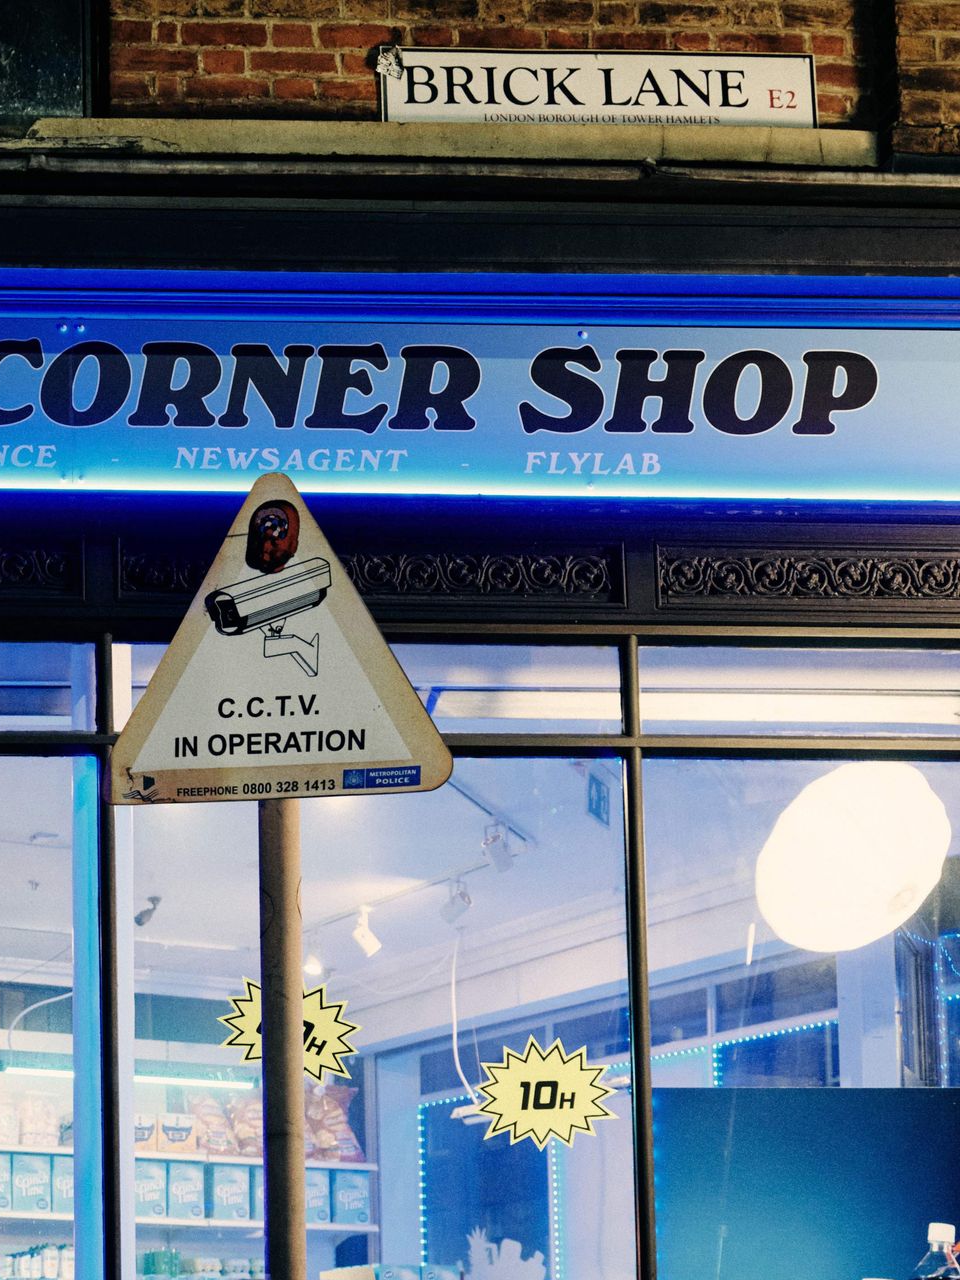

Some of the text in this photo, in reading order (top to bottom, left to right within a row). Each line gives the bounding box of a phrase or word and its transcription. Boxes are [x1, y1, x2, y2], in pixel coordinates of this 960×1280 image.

[403, 65, 798, 110] BRICK LANE E2
[483, 113, 721, 125] LONDON BOROUGH OF TOWER HAMLETS
[517, 344, 879, 436] SHOP
[173, 445, 409, 475] NEWSAGENT
[523, 450, 663, 477] FLYLAB
[217, 694, 321, 719] C.C.T.V.
[174, 729, 366, 758] IN OPERATION
[369, 769, 417, 777] METROPOLITAN
[375, 777, 410, 785] POLICE
[176, 779, 336, 798] FREEPHONE 0800 328 1413
